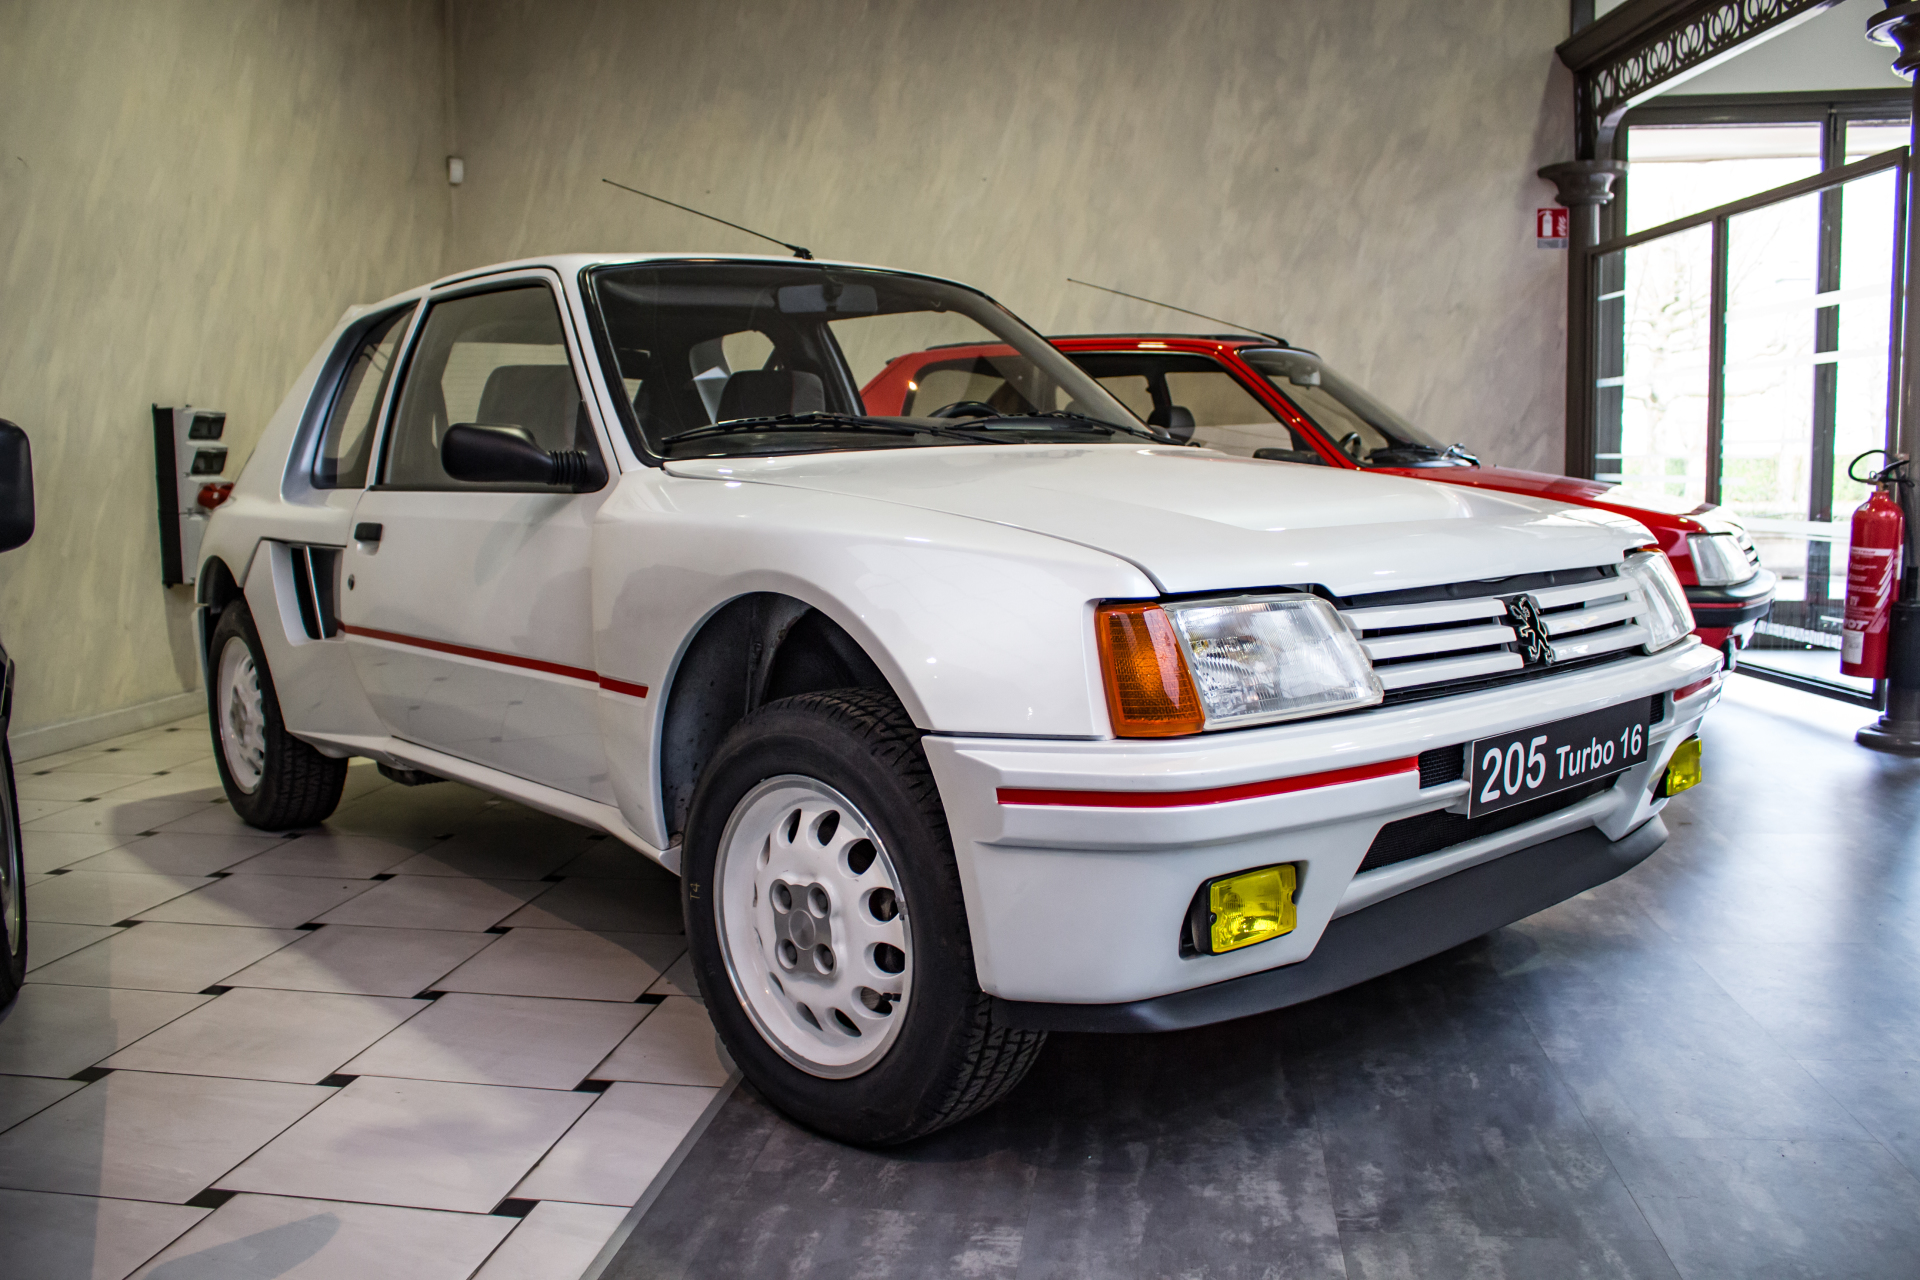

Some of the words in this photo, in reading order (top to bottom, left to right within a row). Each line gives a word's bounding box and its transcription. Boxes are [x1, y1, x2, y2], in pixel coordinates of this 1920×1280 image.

[1480, 735, 1547, 803] 205
[1556, 736, 1615, 780] Turbo
[1620, 723, 1643, 759] 16
[689, 882, 701, 901] T4
